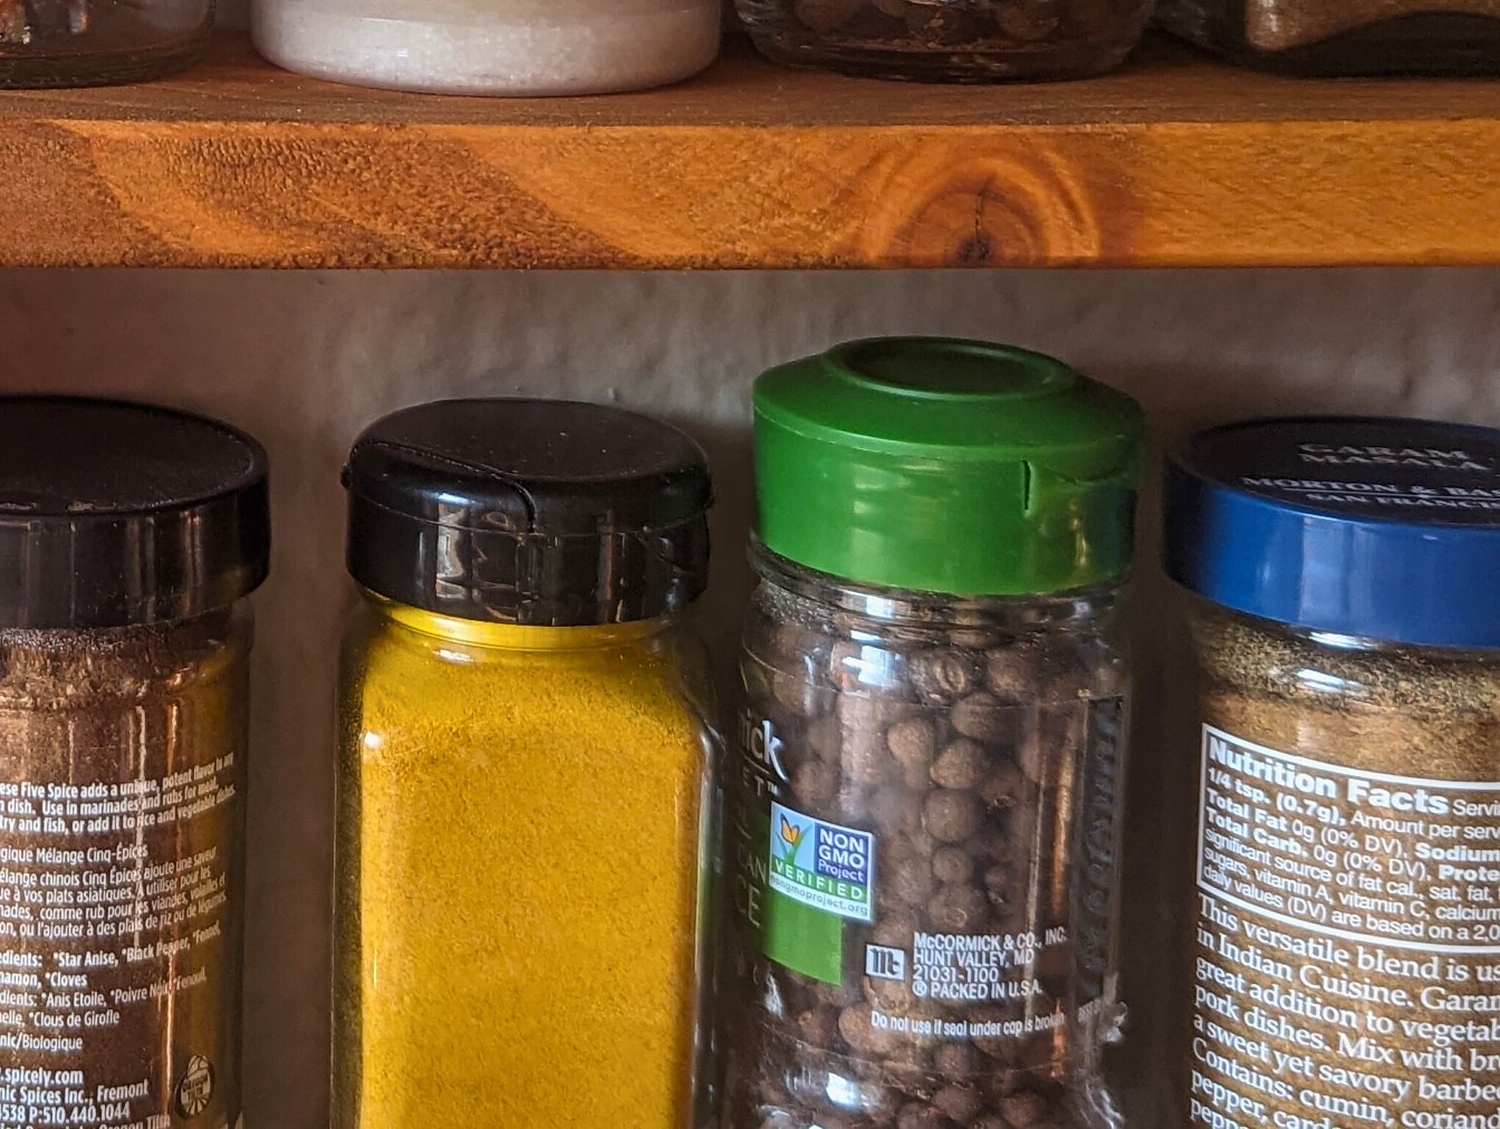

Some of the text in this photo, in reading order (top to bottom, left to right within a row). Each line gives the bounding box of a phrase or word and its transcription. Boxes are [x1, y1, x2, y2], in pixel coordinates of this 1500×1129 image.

[1241, 477, 1400, 493] MORTON
[1210, 736, 1449, 814] Nutrition Facts
[21, 782, 45, 798] Five
[48, 783, 78, 800] Spice
[80, 782, 108, 798] adds
[1208, 767, 1232, 790] 1/4
[1235, 778, 1271, 804] tsp.
[1351, 810, 1425, 835] Amount
[1429, 823, 1460, 840] per
[8, 798, 36, 814] dish.
[19, 818, 40, 832] and
[44, 817, 69, 835] fish,
[820, 828, 864, 853] NON
[36, 846, 84, 865] Mélange
[819, 845, 865, 869] GMO
[775, 859, 863, 900] VERIFIED
[818, 859, 864, 882] Project
[1199, 893, 1470, 982] This versatile blend is
[84, 950, 118, 967] Anise,
[914, 949, 1035, 968] HUNT VALLEY, MD
[1218, 932, 1414, 1008] Indian Cuisine.
[913, 965, 999, 983] 21031-1100
[930, 979, 1043, 999] PACKED U.S.A.
[1196, 956, 1394, 1034] great addition to
[871, 1011, 1000, 1036] Do not seal under
[1194, 985, 1462, 1071] pork dishes. Mix with
[1208, 1020, 1412, 1102] sweet yet savory
[20, 1087, 62, 1105] Spices
[97, 1079, 149, 1102] Fremont
[1193, 1037, 1394, 1124] Contains: cumin,
[1191, 1070, 1267, 1124] pepper,
